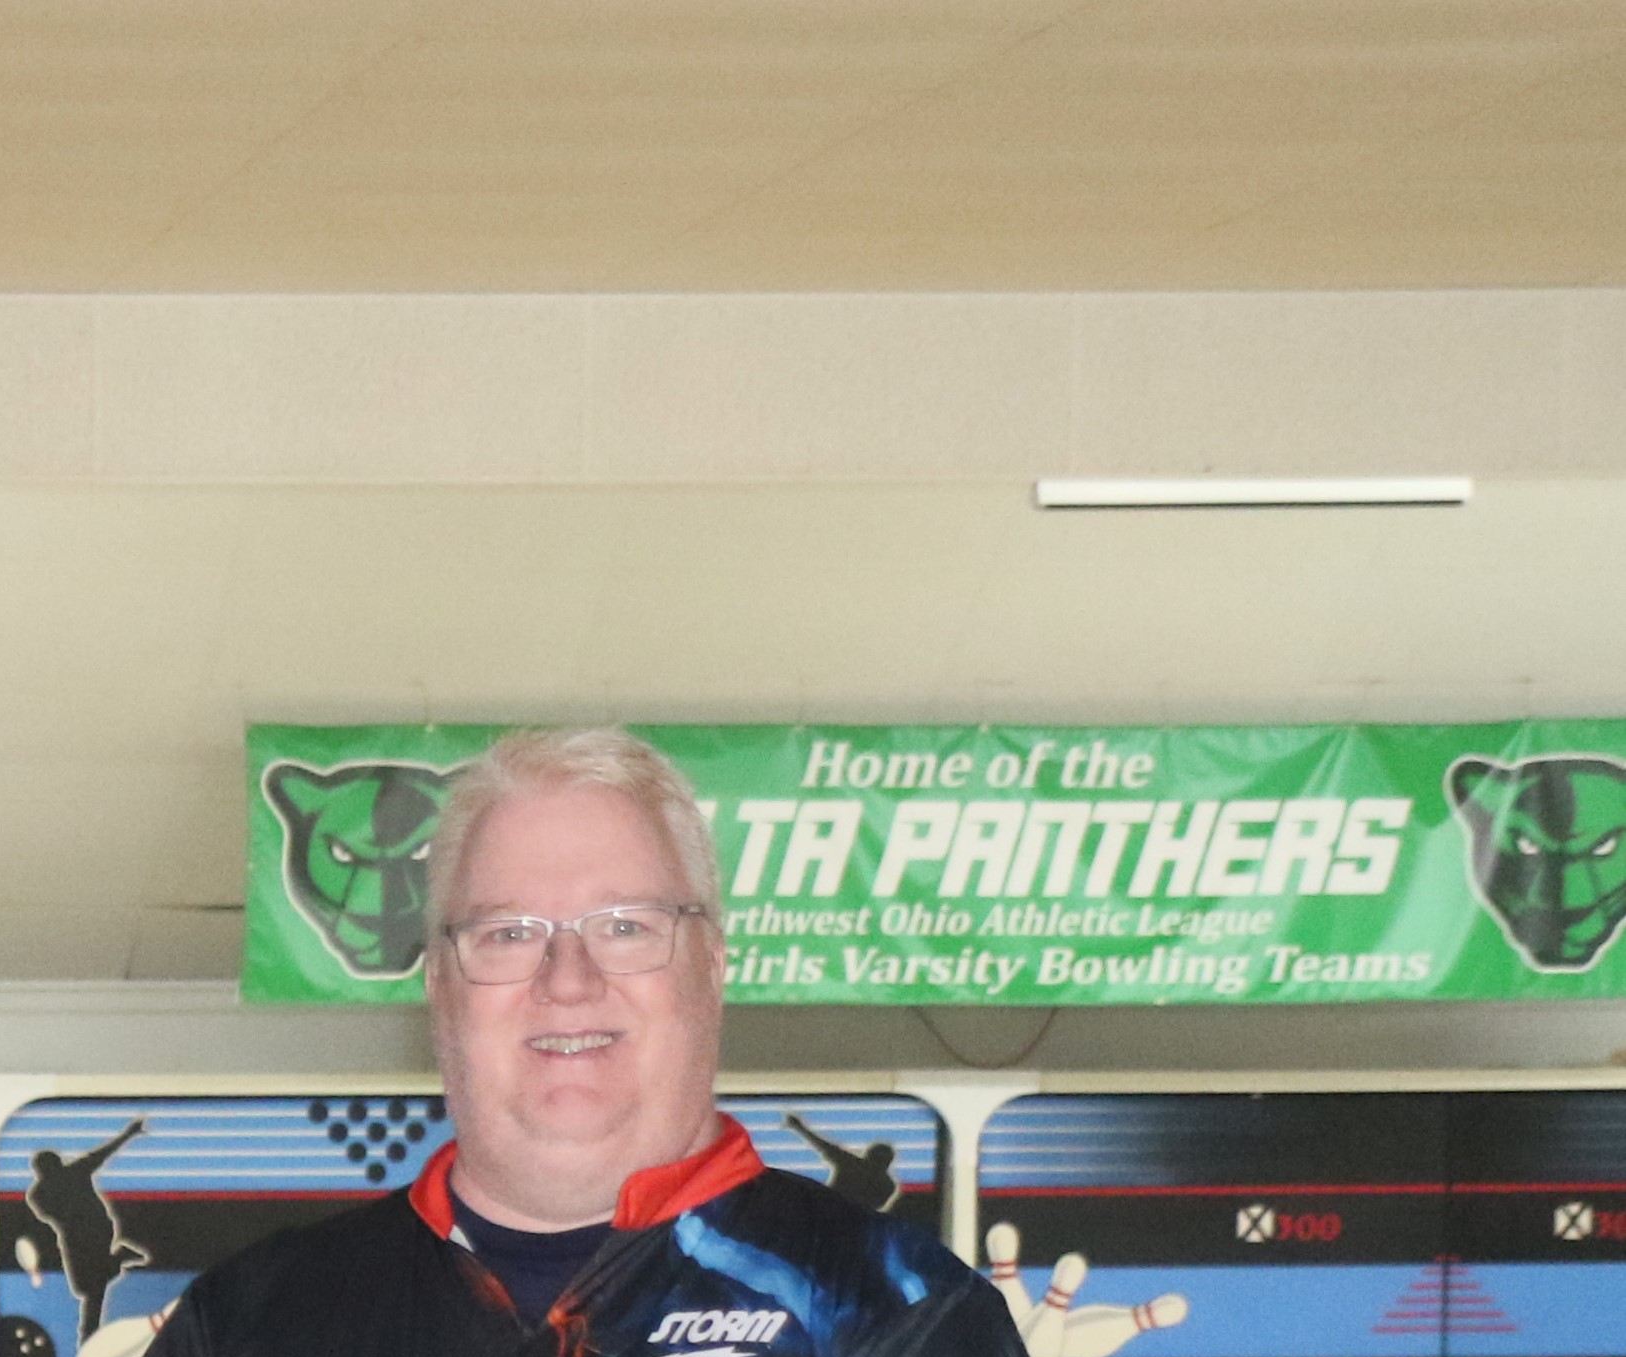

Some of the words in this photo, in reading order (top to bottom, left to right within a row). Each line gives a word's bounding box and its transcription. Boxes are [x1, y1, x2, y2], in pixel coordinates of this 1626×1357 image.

[800, 740, 973, 789] Home
[986, 741, 1053, 788] of
[1060, 739, 1154, 789] the
[871, 797, 1414, 898] PANTHERS
[724, 901, 872, 937] rthwest
[881, 903, 972, 937] Ohio
[979, 902, 1129, 937] Athletic
[1138, 904, 1273, 942] League
[843, 947, 1026, 994] Varsity
[1036, 946, 1246, 994] Bowling
[1264, 946, 1433, 984] Teams
[648, 1310, 788, 1344] STORM
